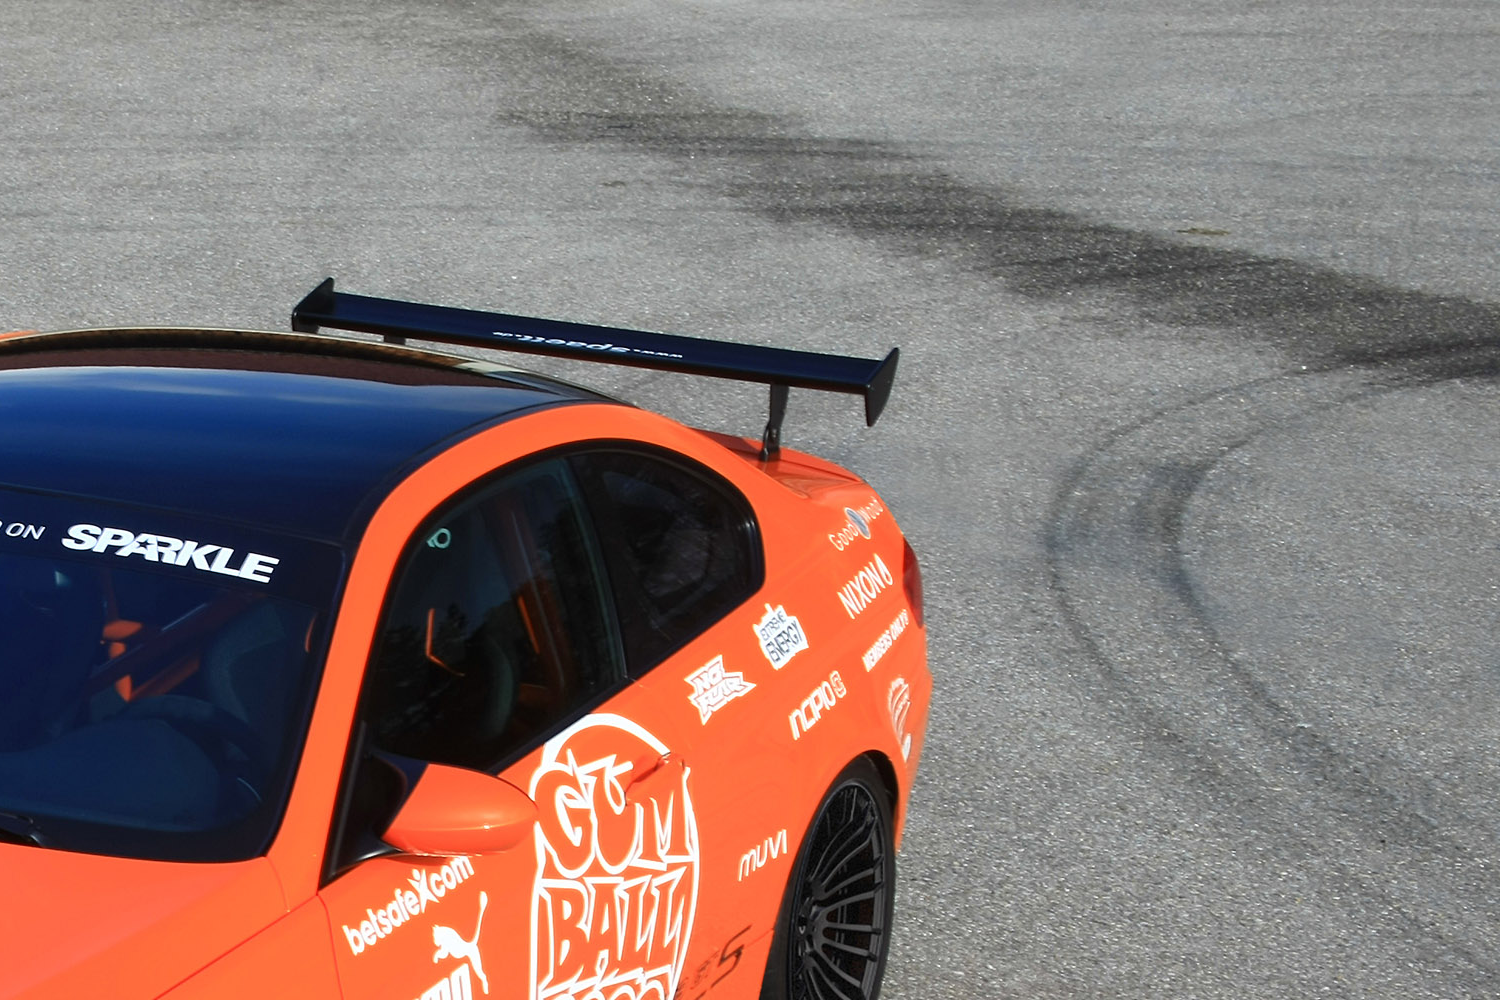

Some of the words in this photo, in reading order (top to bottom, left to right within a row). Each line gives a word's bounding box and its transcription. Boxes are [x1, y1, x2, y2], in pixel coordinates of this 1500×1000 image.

[5, 522, 46, 540] ON
[61, 523, 280, 584] SPARKLE
[837, 562, 886, 619] NIXON
[765, 620, 803, 663] ENERGY
[538, 867, 687, 992] BALL
